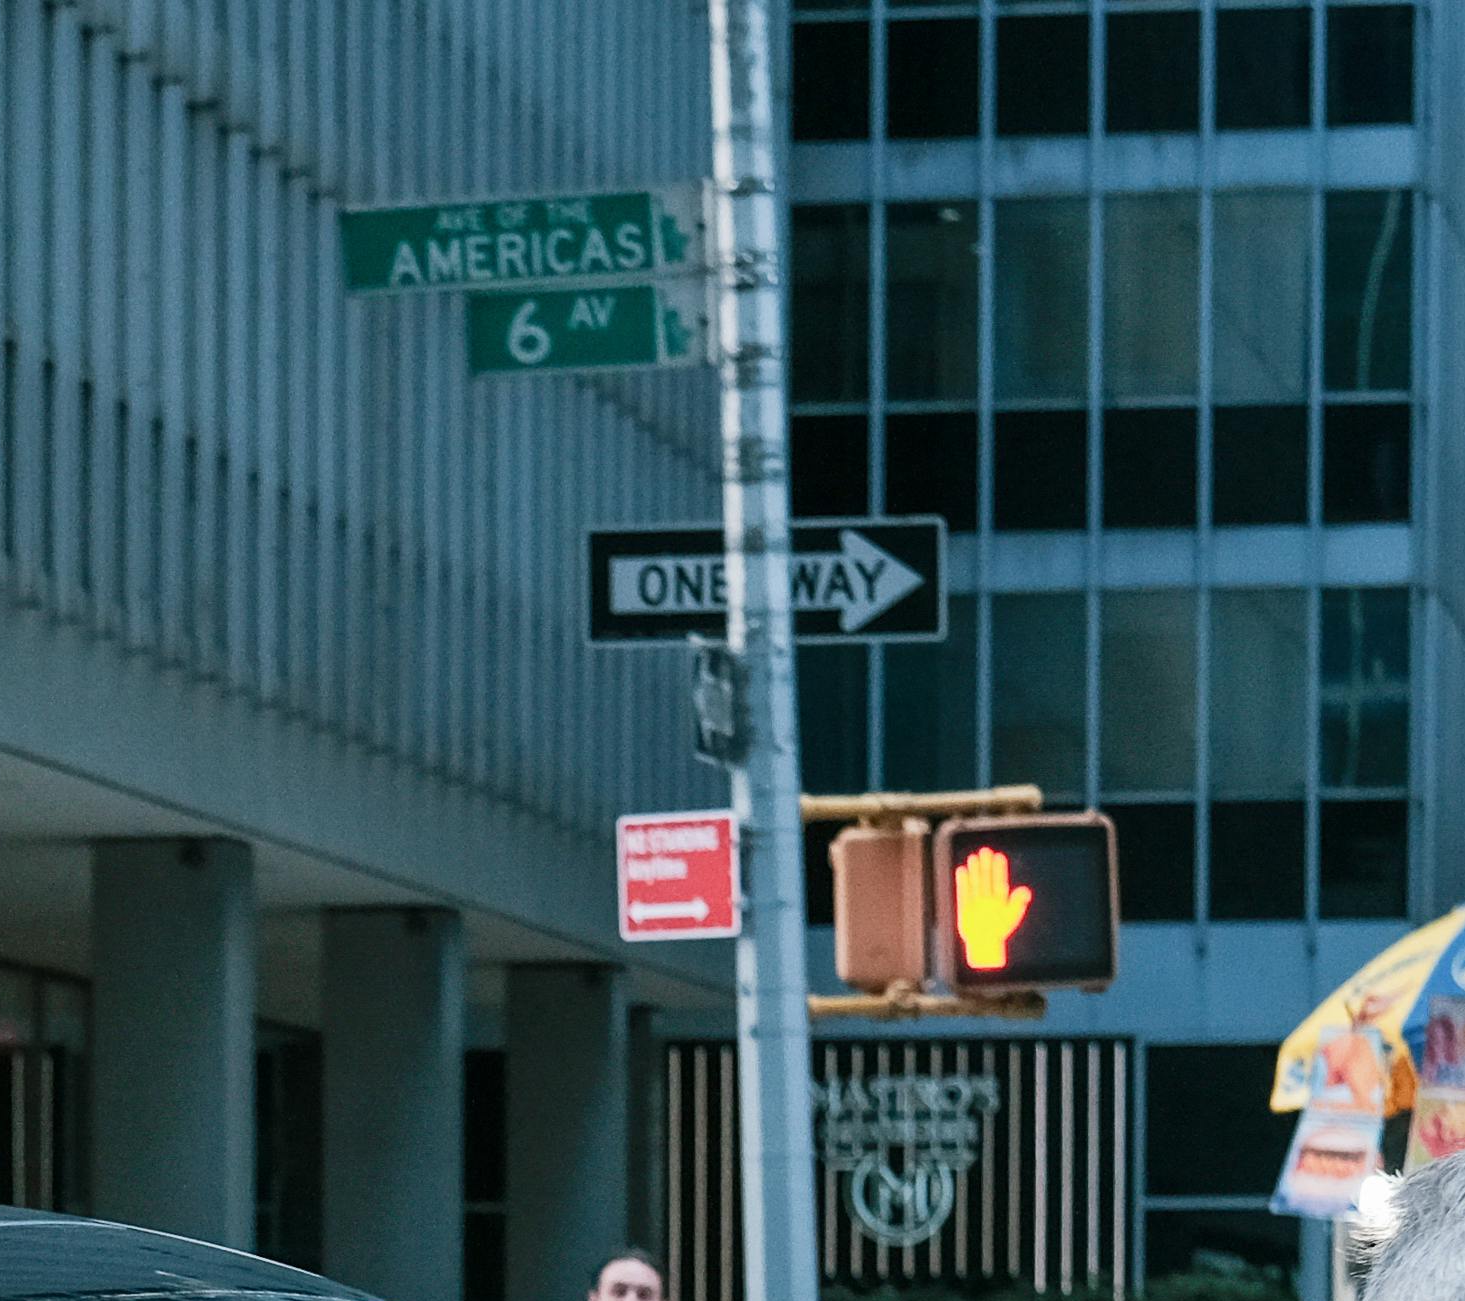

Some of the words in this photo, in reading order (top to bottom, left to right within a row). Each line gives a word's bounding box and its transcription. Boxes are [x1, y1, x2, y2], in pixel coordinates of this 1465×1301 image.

[389, 223, 645, 288] AMERICAS
[507, 301, 551, 364] 6
[568, 296, 617, 331] AV
[791, 558, 886, 602] WAY
